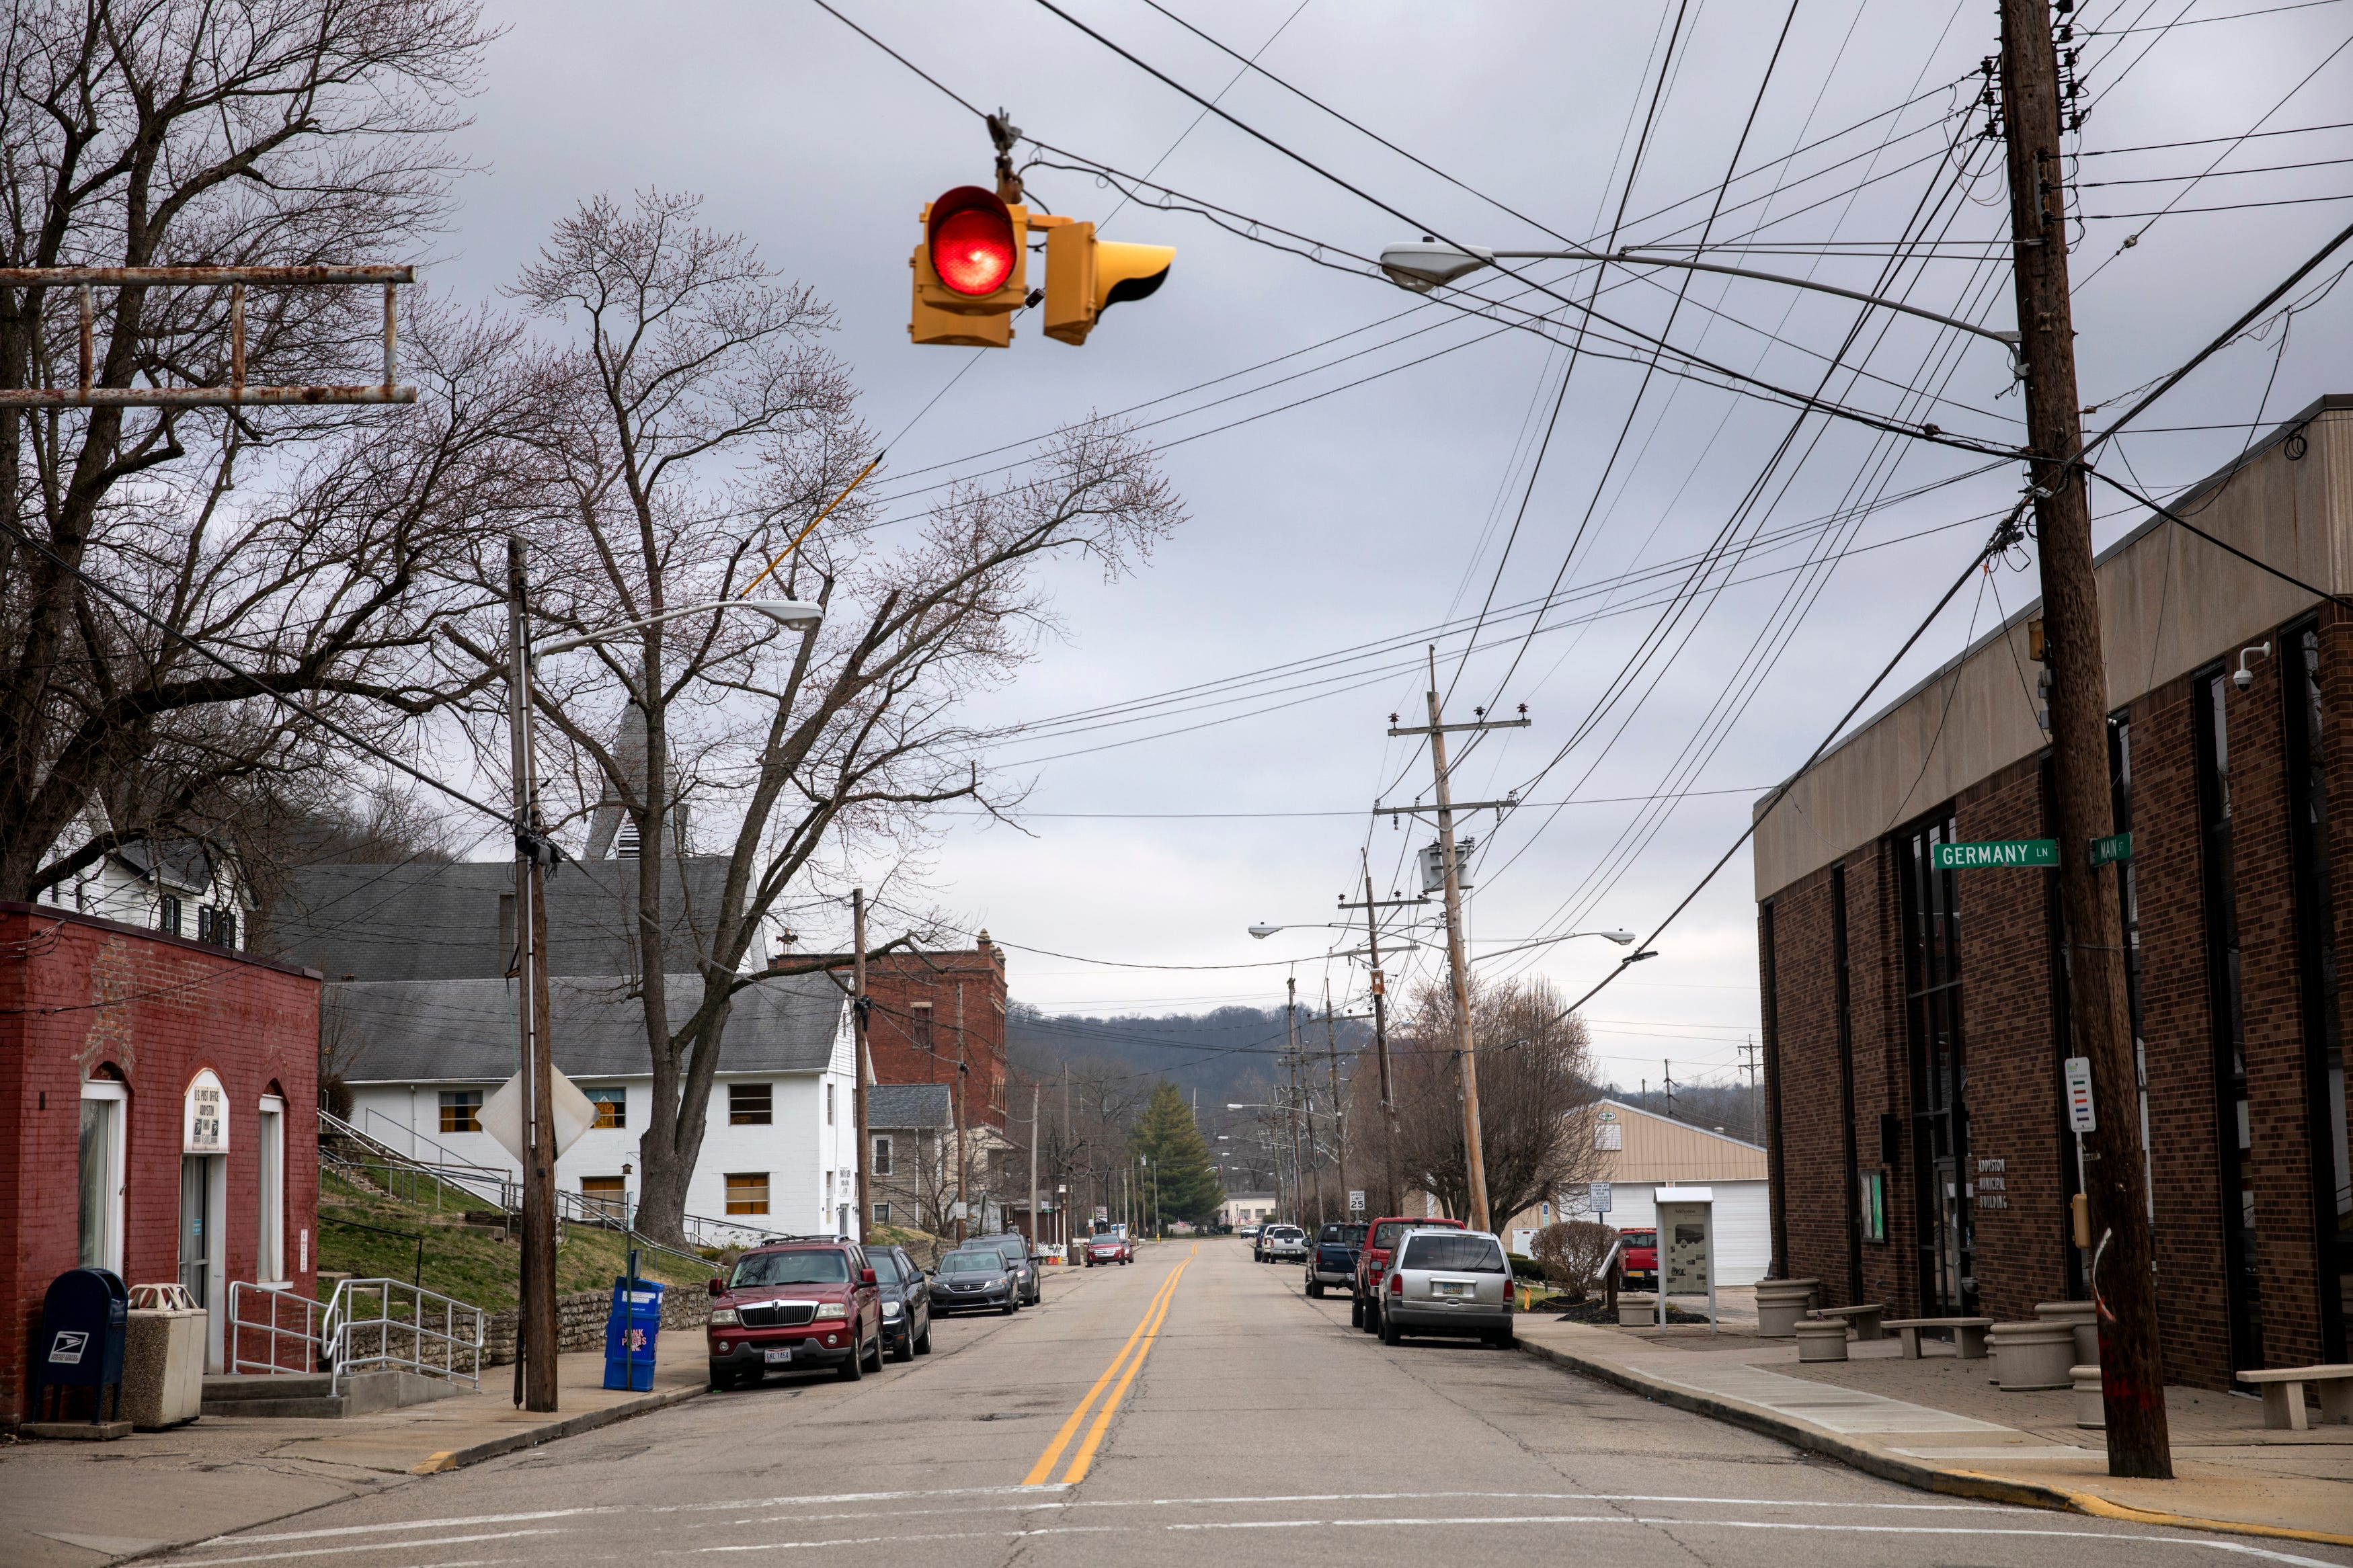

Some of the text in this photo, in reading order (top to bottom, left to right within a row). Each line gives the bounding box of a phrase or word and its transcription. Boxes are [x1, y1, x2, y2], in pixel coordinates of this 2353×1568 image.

[1943, 844, 2048, 865] GERMANY LN
[2101, 839, 2124, 859] MAIN ST
[209, 1090, 219, 1102] OFFICE
[200, 1104, 214, 1116] ADDYSTON
[1979, 1158, 2005, 1173] ADDYSTON
[1979, 1177, 2007, 1190] MUNICIPAL
[1979, 1195, 2007, 1208] BUILDING
[621, 1337, 647, 1346] PGES
